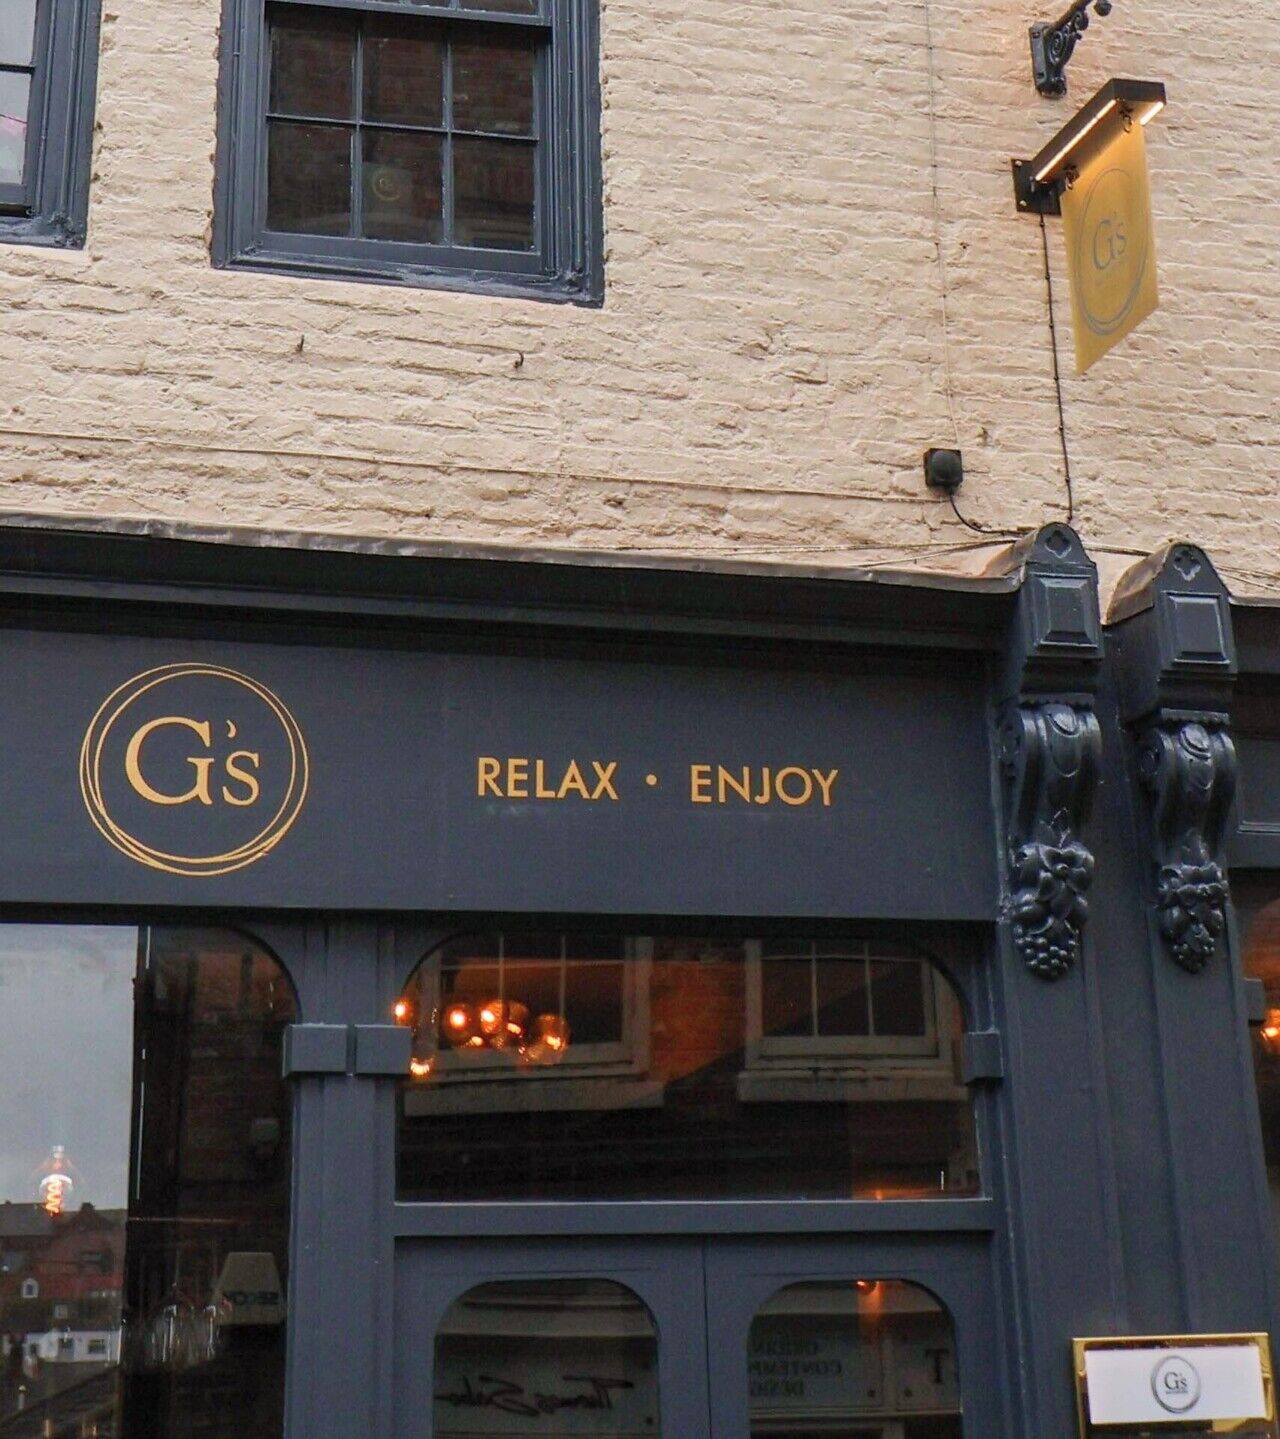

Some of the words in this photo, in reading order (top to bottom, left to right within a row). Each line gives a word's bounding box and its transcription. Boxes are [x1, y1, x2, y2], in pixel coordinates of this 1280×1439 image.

[125, 716, 260, 806] G's
[477, 757, 619, 800] RELAX
[690, 764, 839, 807] ENJOY
